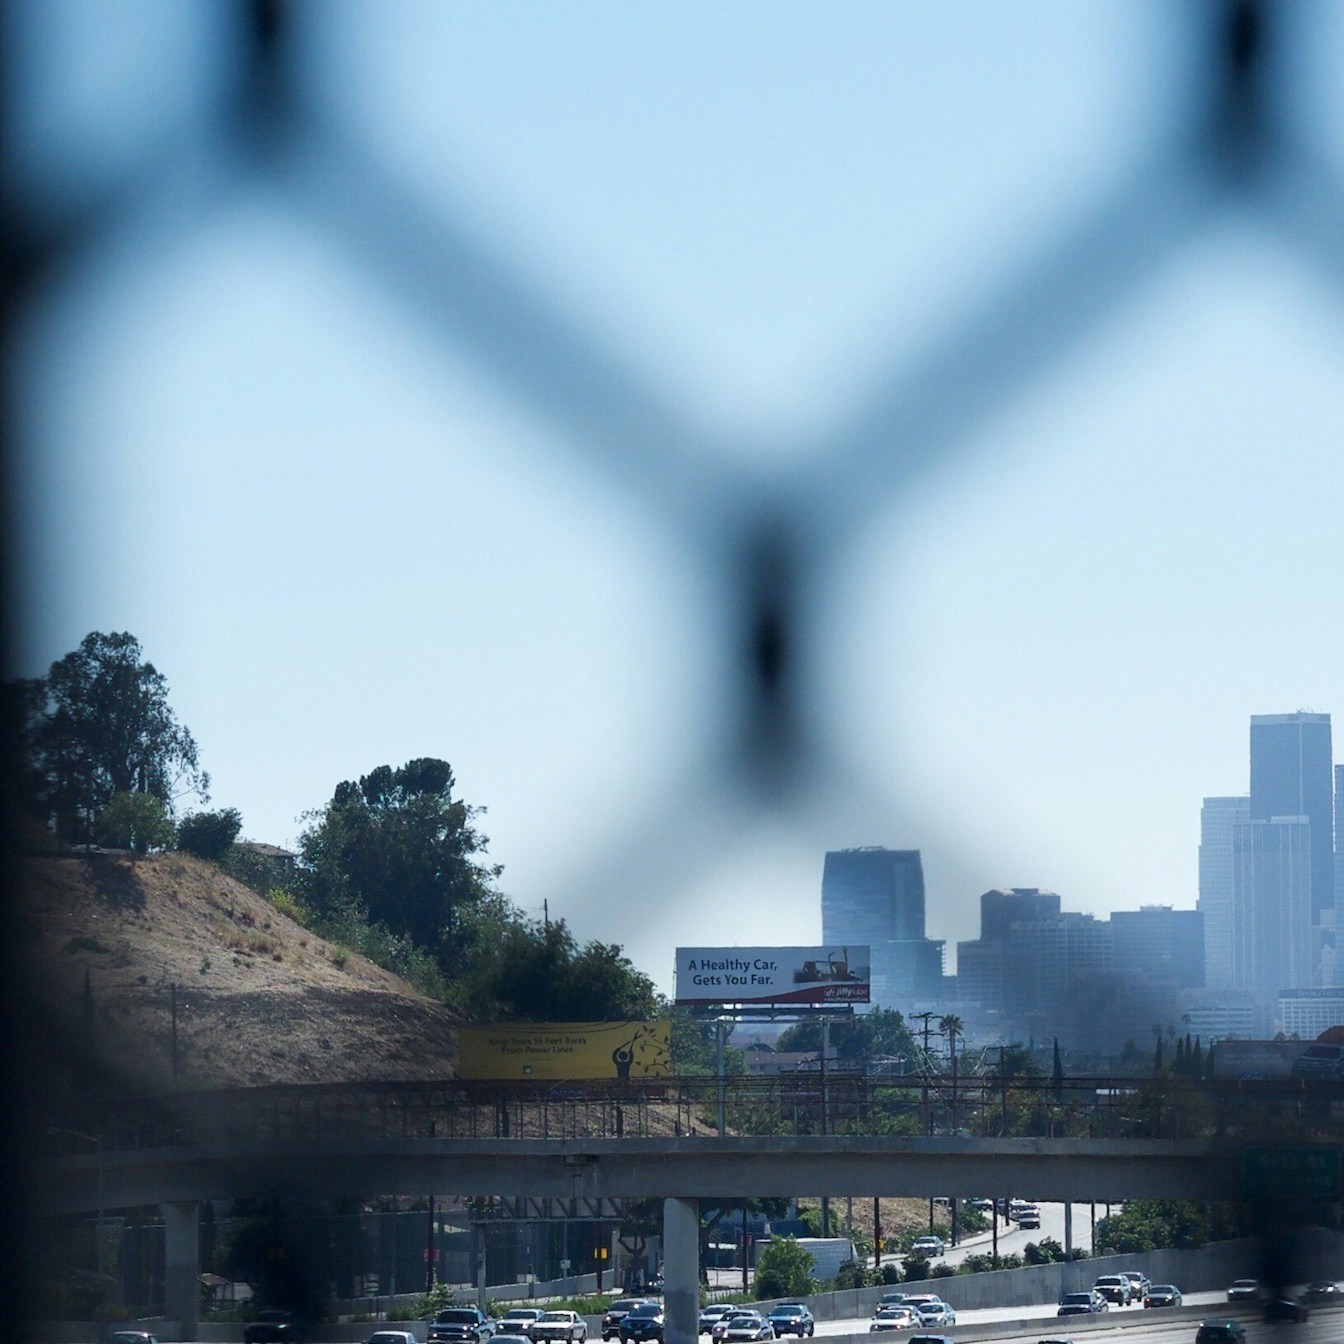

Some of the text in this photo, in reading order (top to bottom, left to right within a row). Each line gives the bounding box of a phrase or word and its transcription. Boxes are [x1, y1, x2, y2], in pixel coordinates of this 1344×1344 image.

[688, 959, 777, 972] A Healthy Car,
[693, 974, 773, 985] Gets You Far.
[565, 1037, 587, 1045] Away
[501, 1046, 522, 1054] From
[525, 1046, 550, 1054] Power
